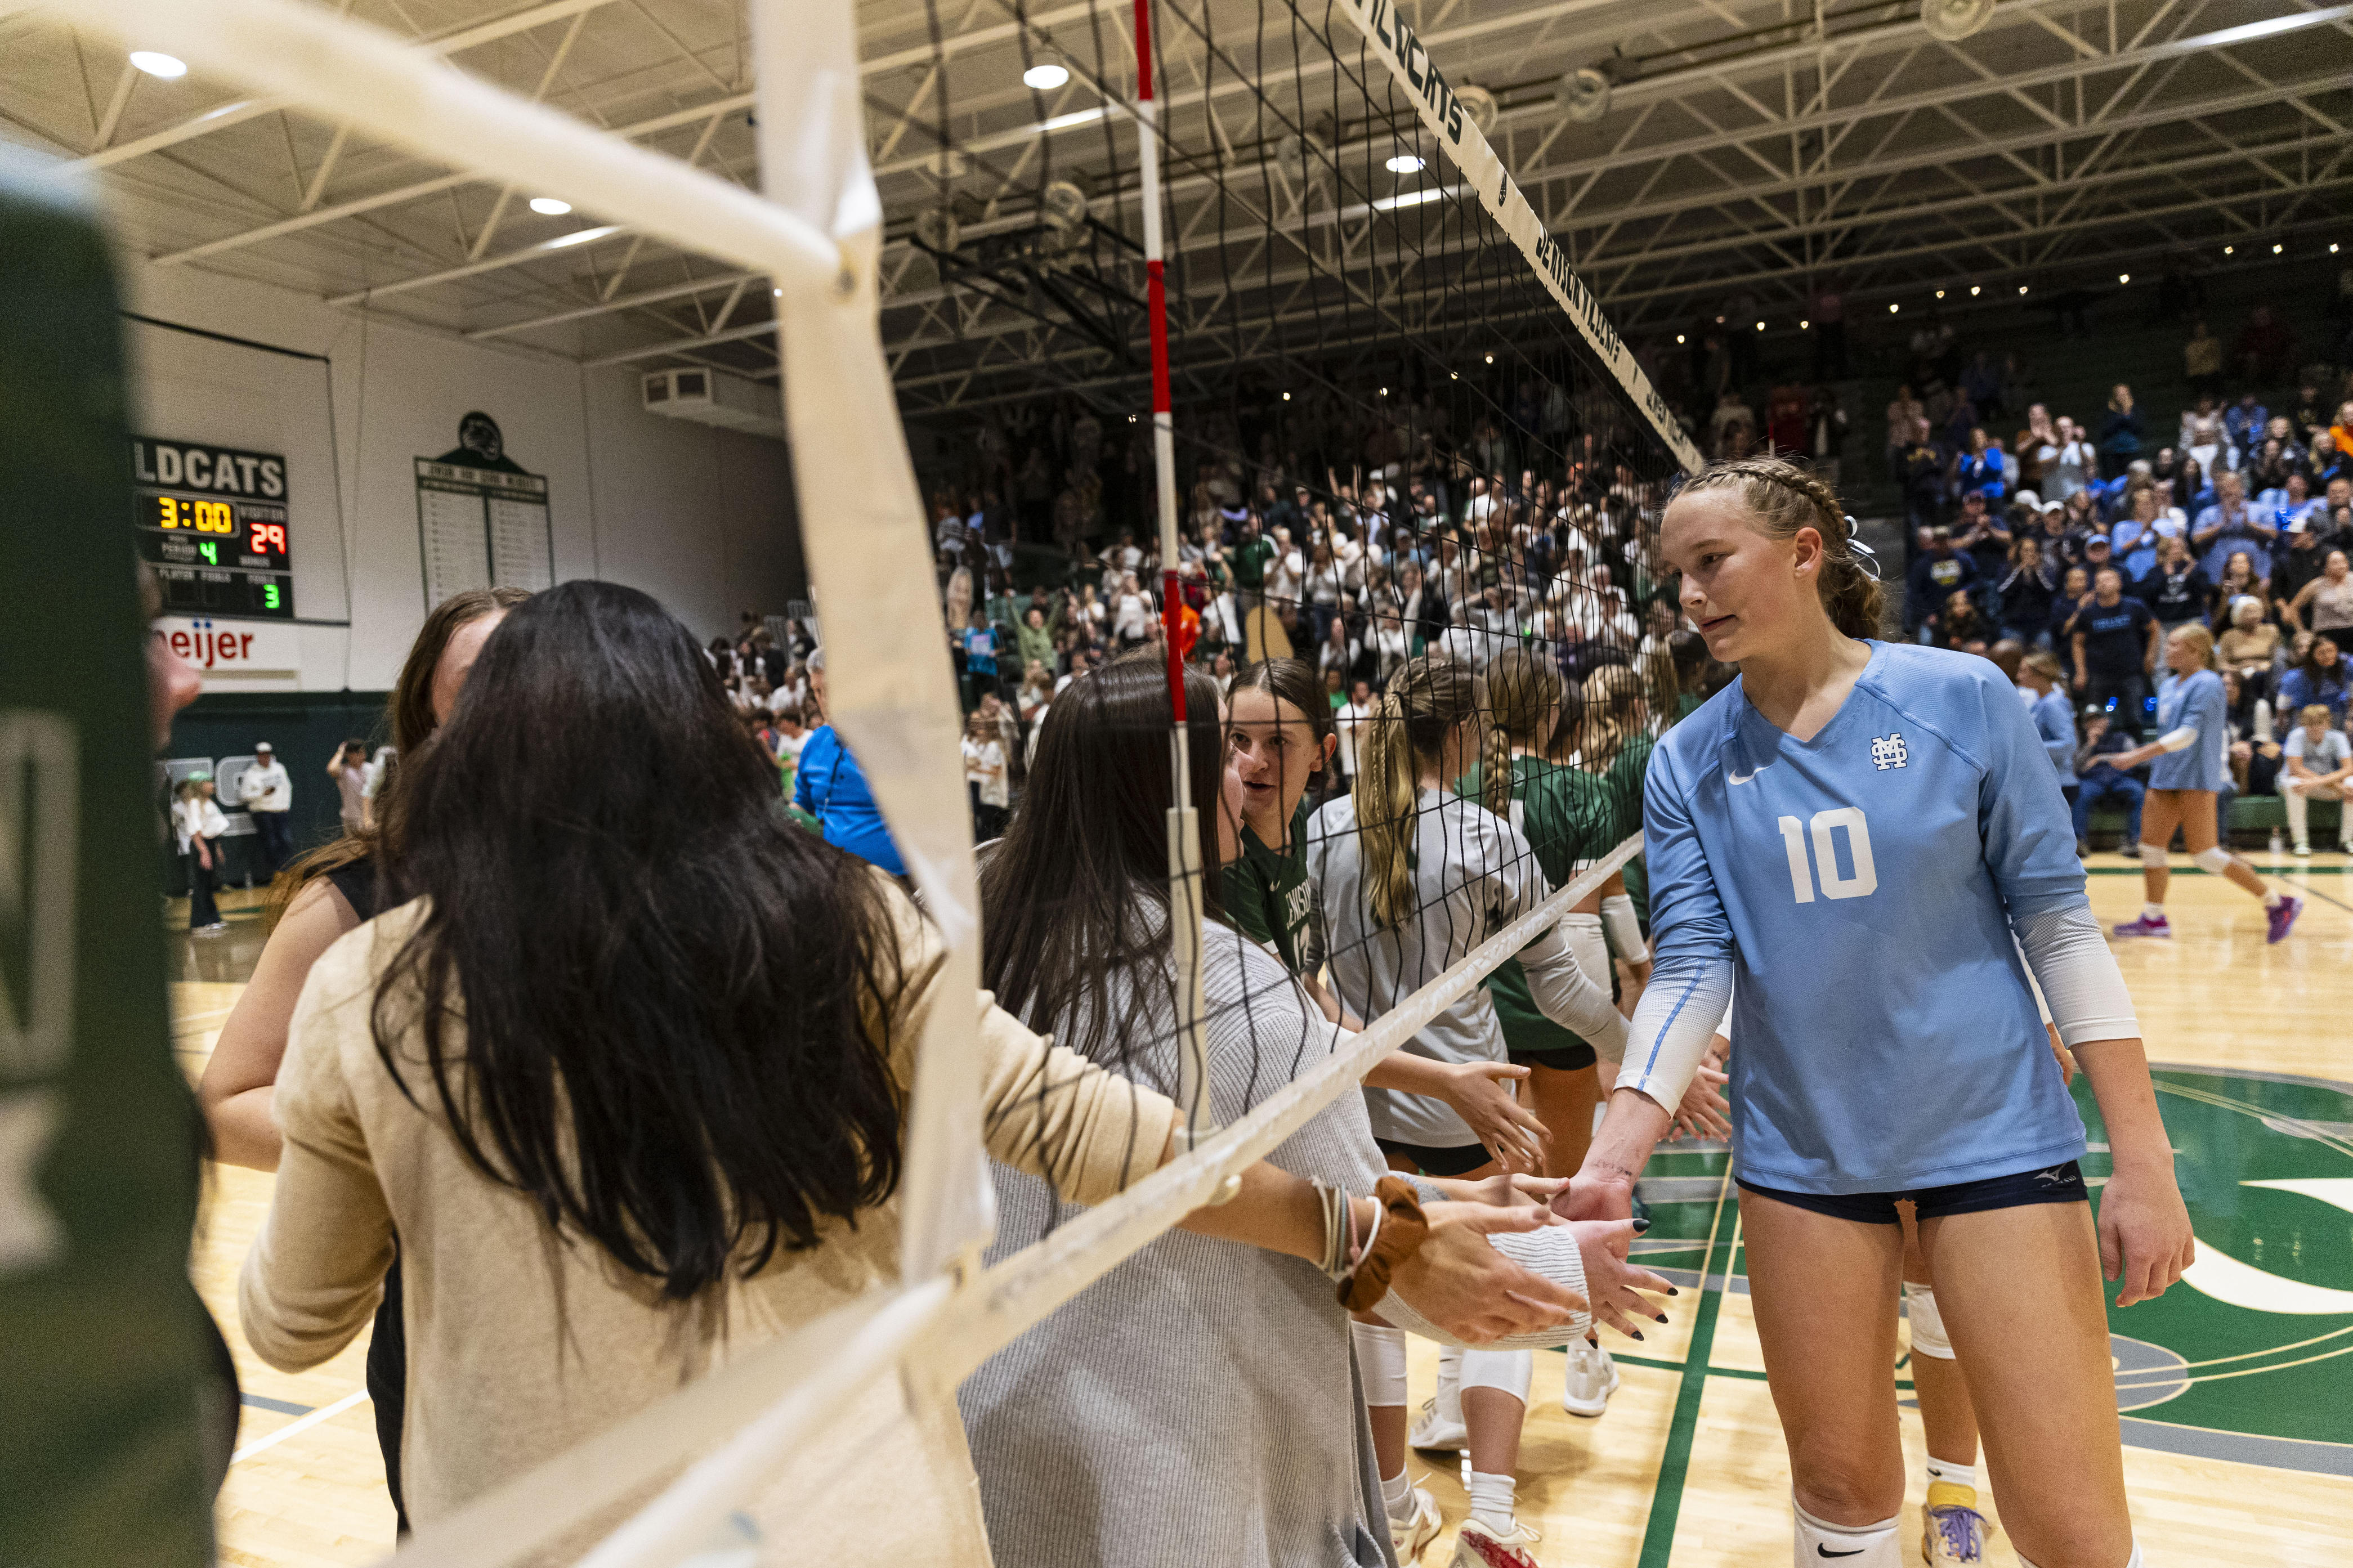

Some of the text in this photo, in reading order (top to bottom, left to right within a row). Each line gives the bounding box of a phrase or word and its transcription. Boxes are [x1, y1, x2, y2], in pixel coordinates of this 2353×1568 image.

[1354, 0, 1463, 145] LDCATS
[159, 496, 232, 534] 3:00
[199, 541, 217, 565] 4
[250, 523, 285, 554] 29
[263, 584, 280, 608] 3
[156, 621, 253, 667] eijer
[1778, 807, 1878, 904] 10
